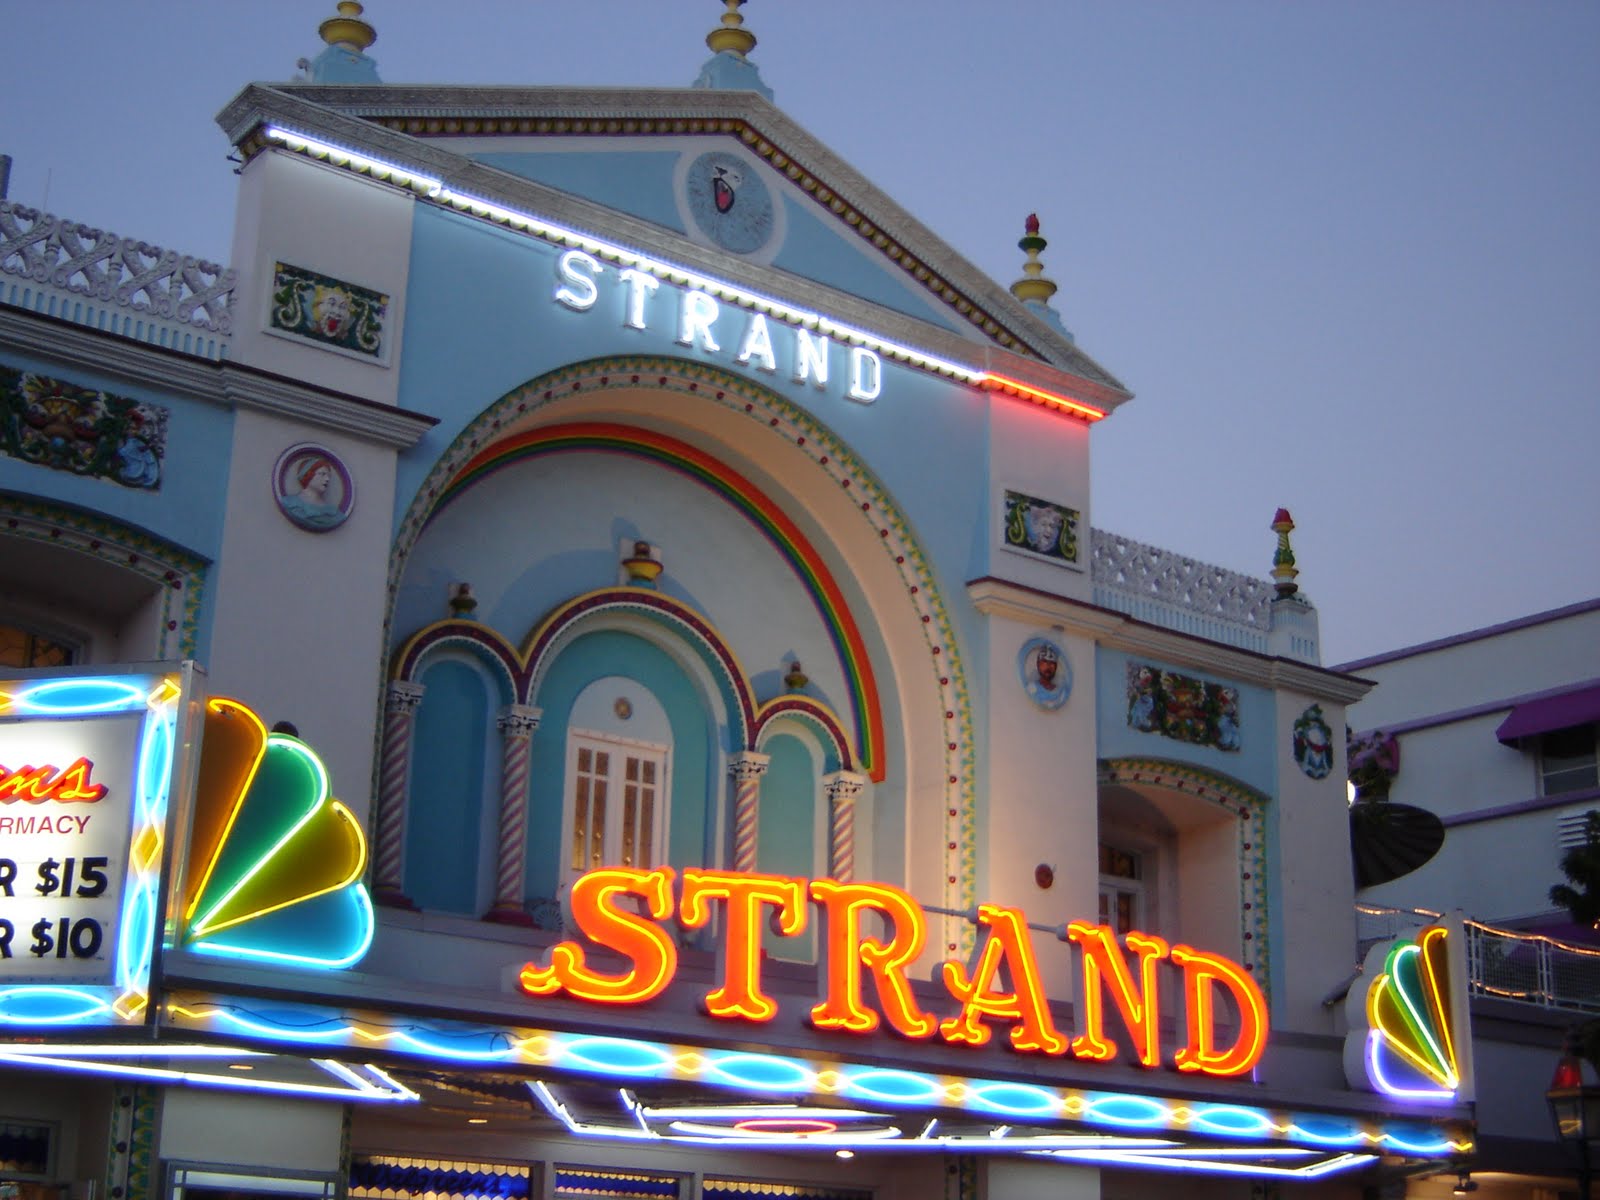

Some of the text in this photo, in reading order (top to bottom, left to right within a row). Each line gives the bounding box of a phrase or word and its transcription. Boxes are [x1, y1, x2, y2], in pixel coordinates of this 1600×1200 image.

[555, 249, 882, 402] STRAND
[35, 857, 108, 898] $15
[30, 918, 102, 958] $10
[519, 866, 1270, 1077] STRAND
